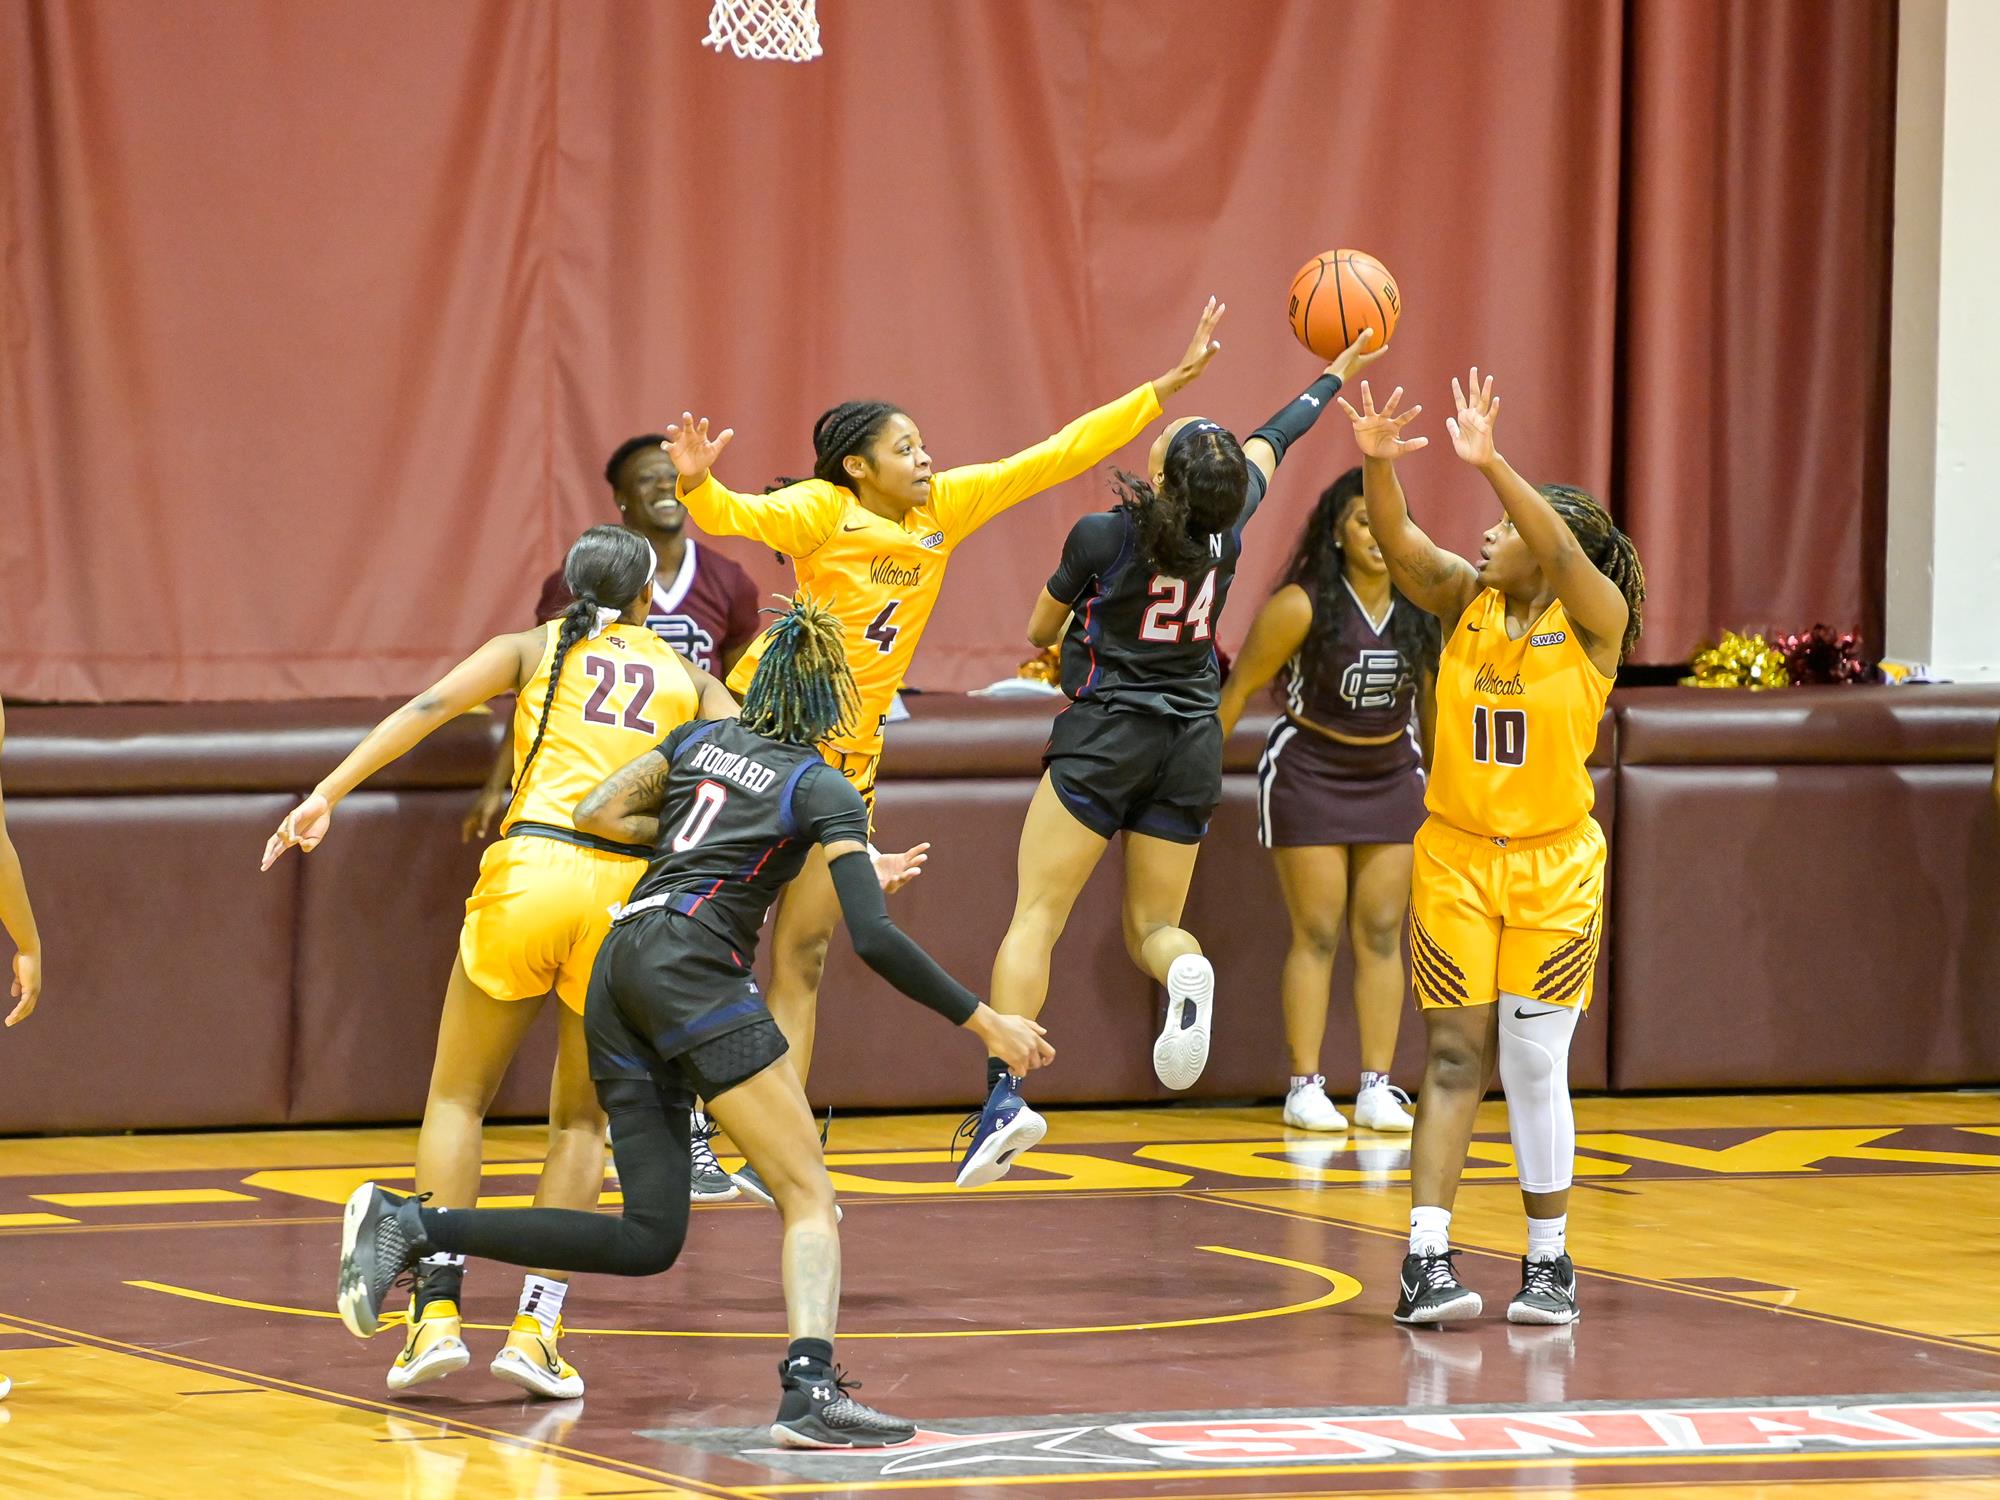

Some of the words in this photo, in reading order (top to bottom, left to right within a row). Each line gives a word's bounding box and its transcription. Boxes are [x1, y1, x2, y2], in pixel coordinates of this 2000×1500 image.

[870, 555, 921, 587] Wildcats
[864, 600, 900, 653] 4
[1139, 567, 1218, 643] 24
[1530, 632, 1566, 647] SWAC
[583, 654, 656, 736] 22
[1473, 704, 1527, 768] 10
[673, 779, 729, 855] 0
